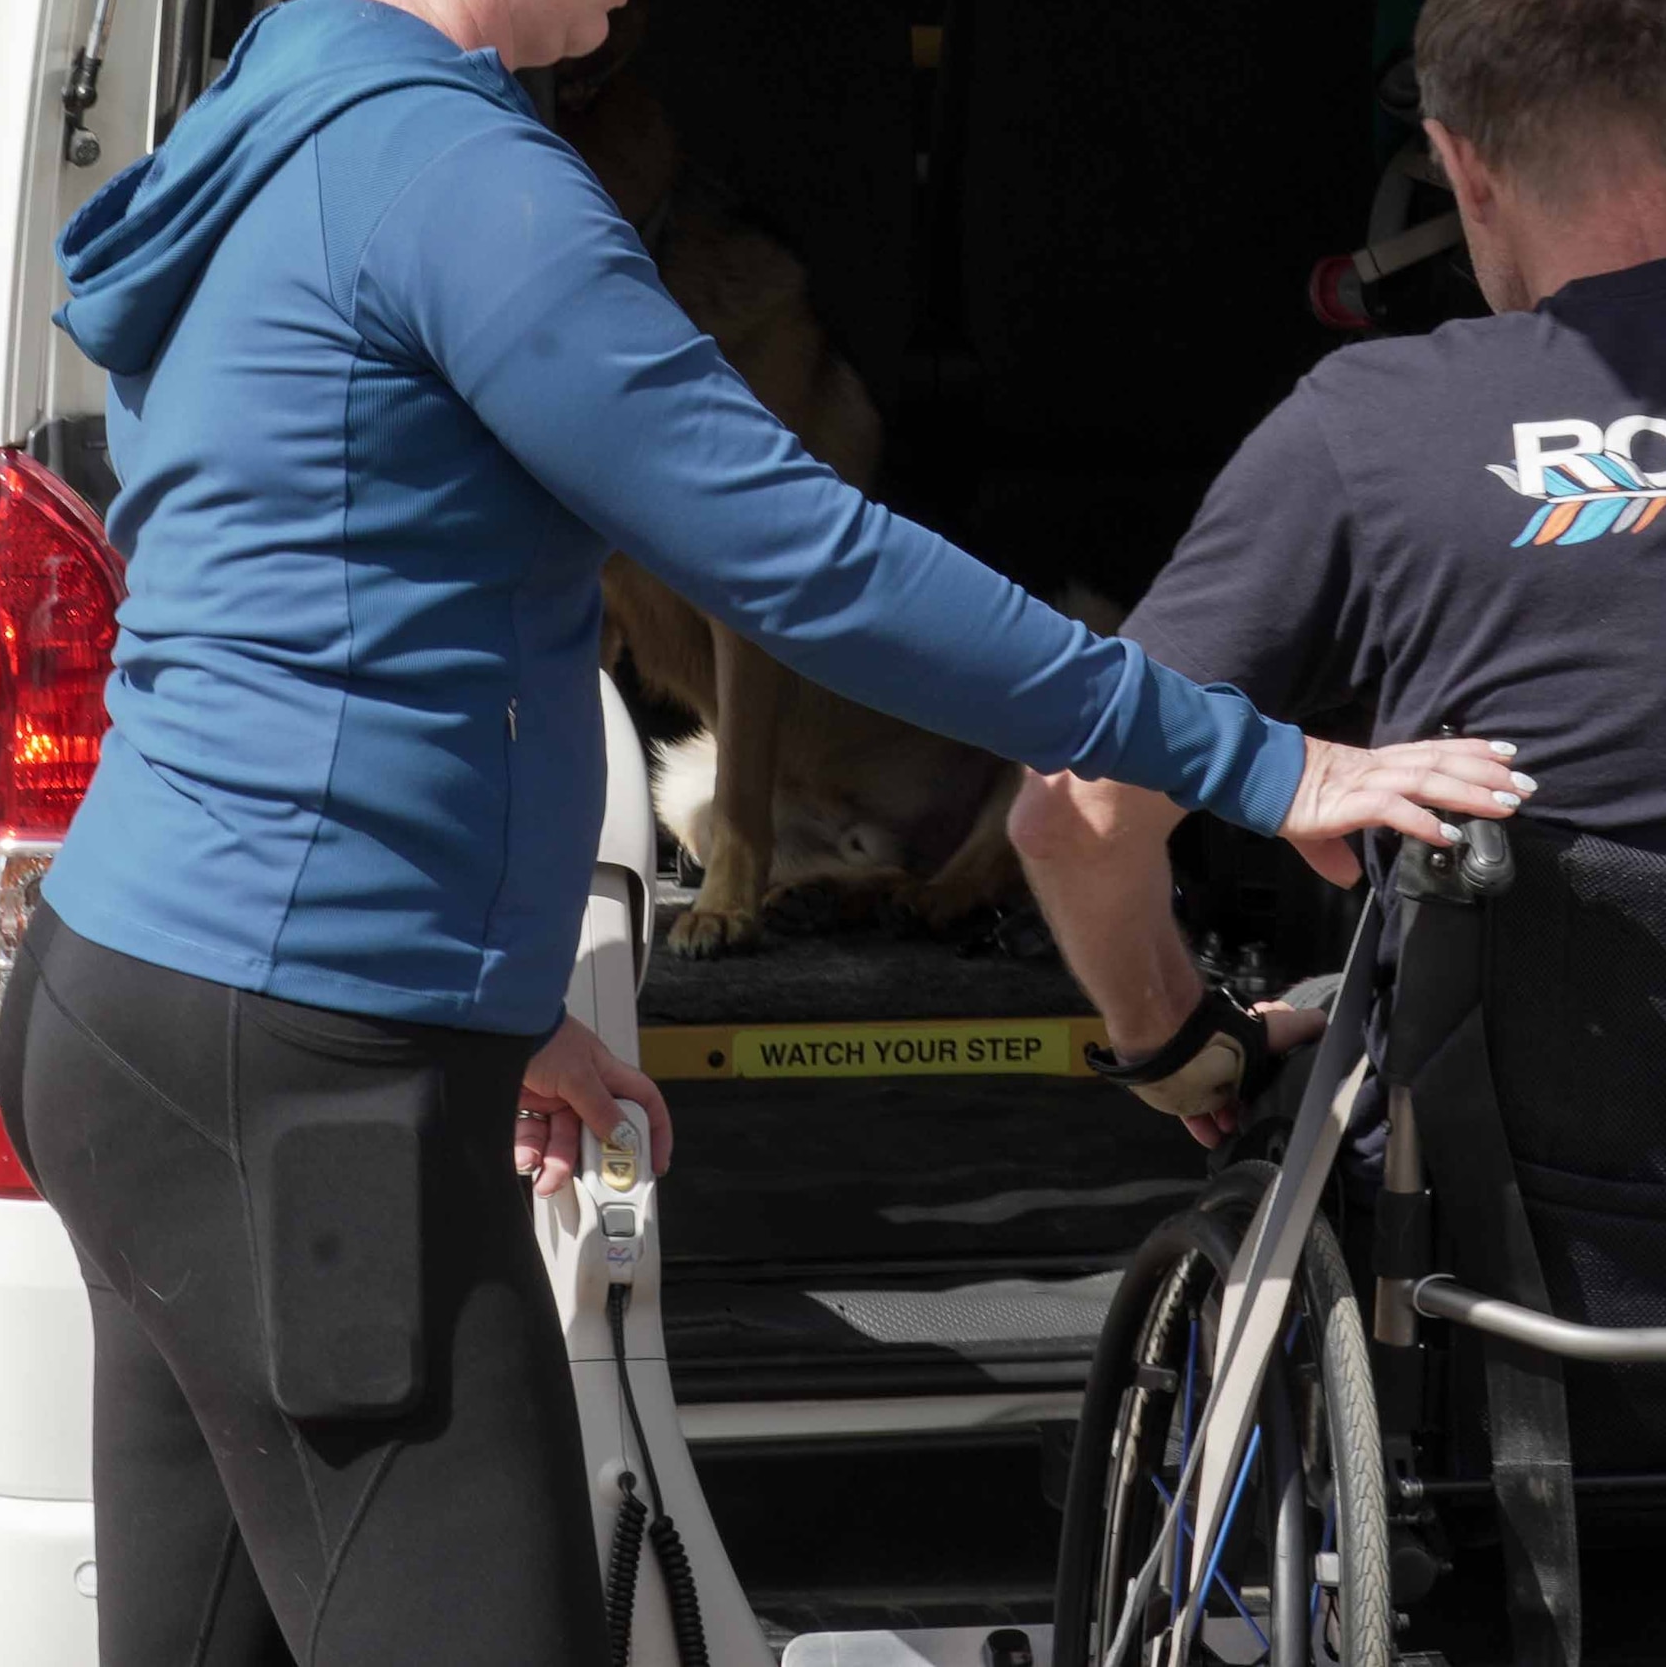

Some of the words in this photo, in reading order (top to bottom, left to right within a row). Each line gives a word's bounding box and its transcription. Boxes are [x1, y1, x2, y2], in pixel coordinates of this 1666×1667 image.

[760, 1040, 866, 1067] WATCH
[872, 1039, 958, 1064] YOUR
[967, 1037, 1043, 1062] STEP
